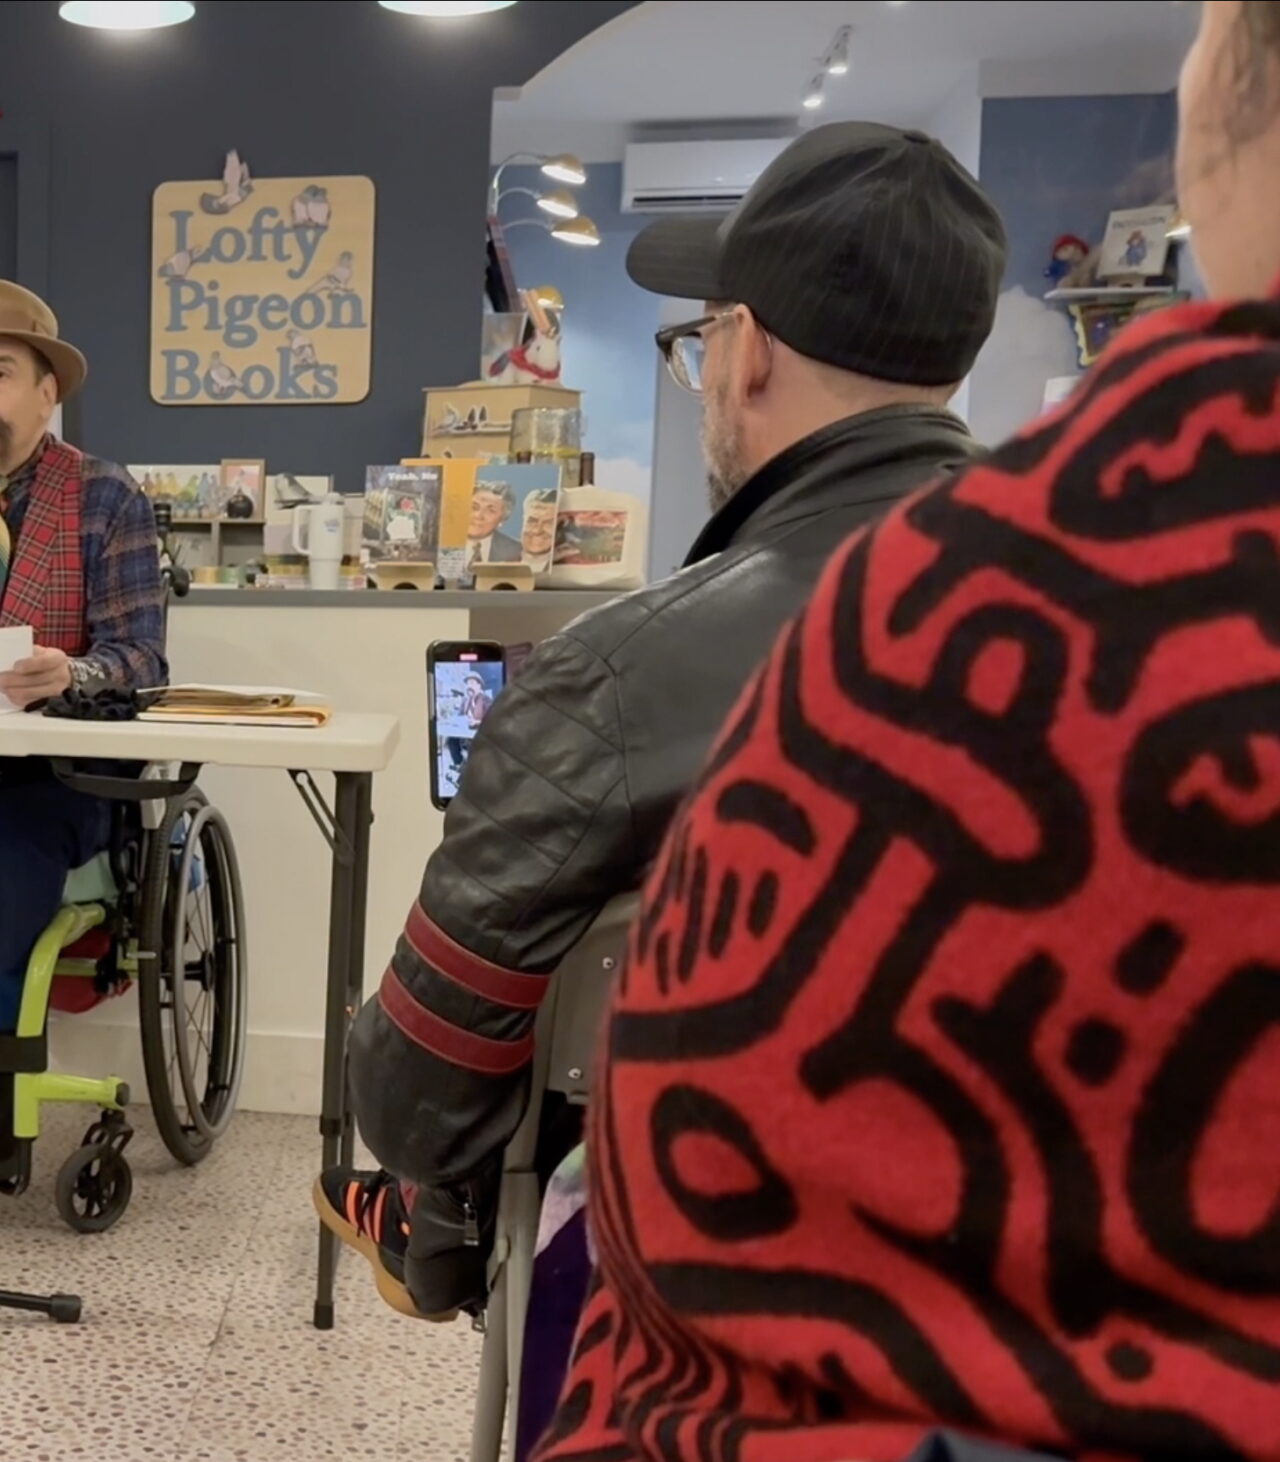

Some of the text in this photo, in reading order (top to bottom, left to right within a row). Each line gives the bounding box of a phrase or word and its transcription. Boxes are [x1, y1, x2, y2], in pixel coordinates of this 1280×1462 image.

[169, 205, 329, 280] Lofty
[164, 277, 367, 349] Pigeon
[160, 346, 339, 401] Books
[421, 472, 438, 481] No
